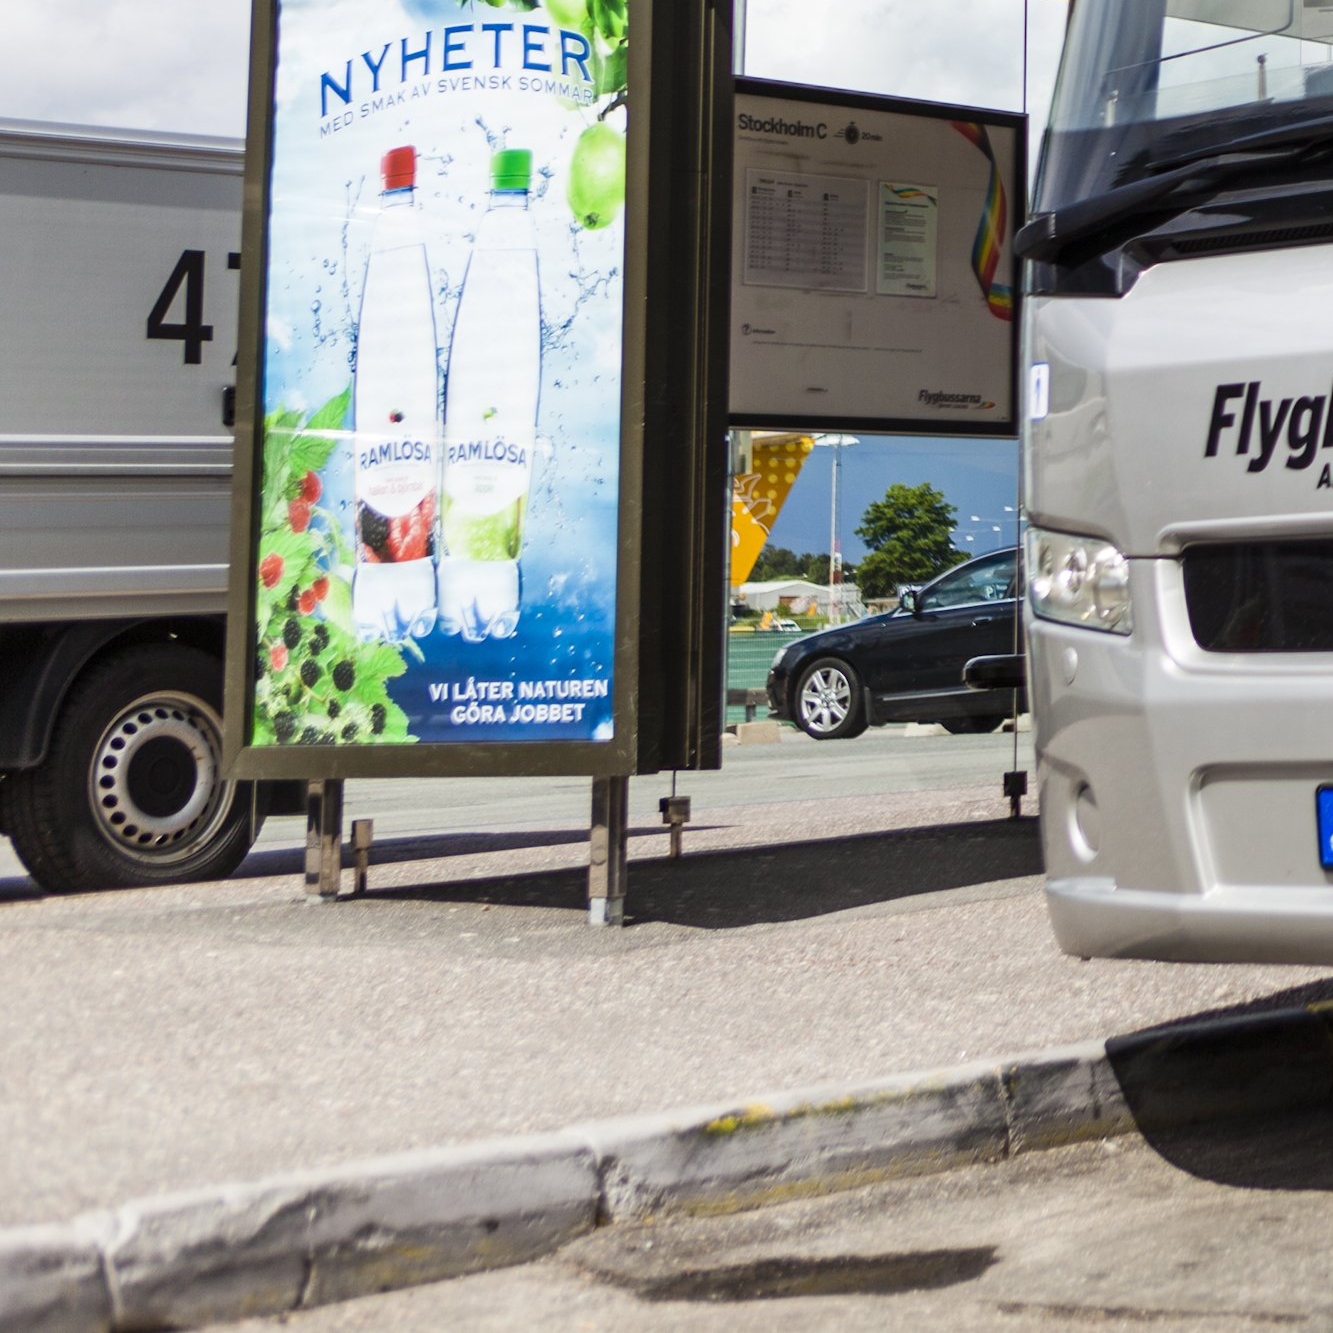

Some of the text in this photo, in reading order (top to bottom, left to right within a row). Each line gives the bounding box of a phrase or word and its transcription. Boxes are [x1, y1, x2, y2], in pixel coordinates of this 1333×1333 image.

[320, 22, 594, 118] NYHETER
[320, 75, 593, 139] MED SMAK AV SVENSK SOMMAR
[738, 113, 828, 139] Stockholm C
[147, 249, 241, 366] 4
[429, 674, 609, 702] VI LÅTER NATUREN
[451, 701, 586, 725] GÖRA JOBBET
